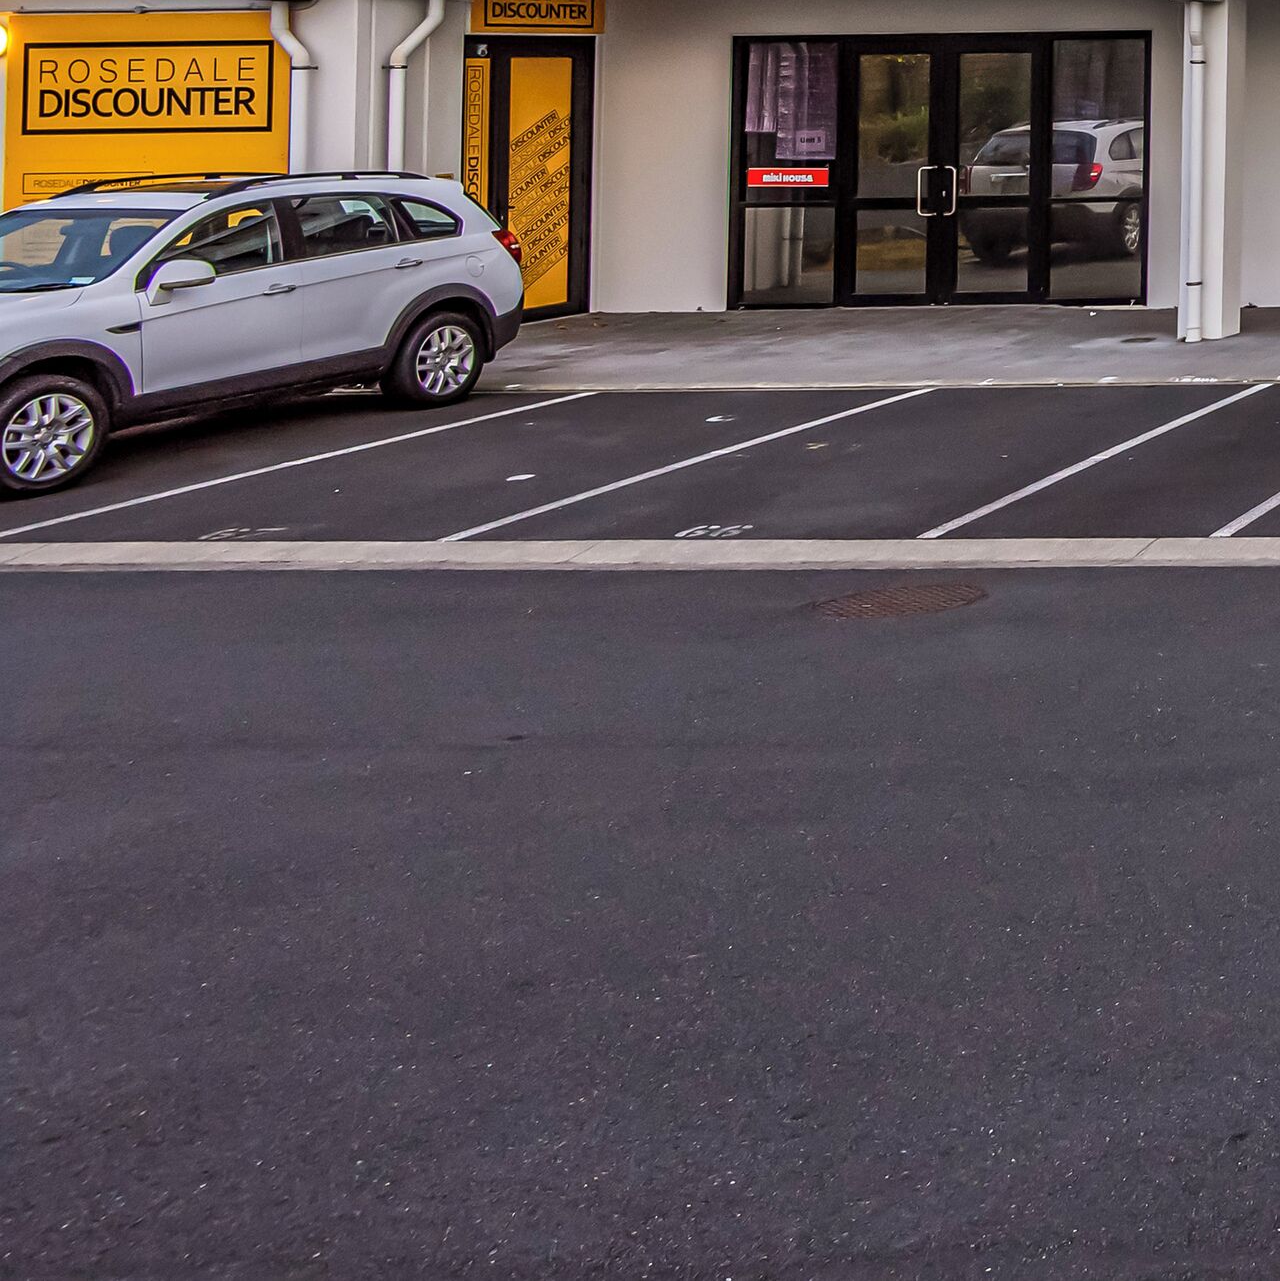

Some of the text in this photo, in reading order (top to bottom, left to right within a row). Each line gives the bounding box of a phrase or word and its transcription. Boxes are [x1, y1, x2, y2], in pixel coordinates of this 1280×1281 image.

[491, 2, 588, 20] DISCOUNTER
[39, 57, 256, 84] ROSEDALE
[38, 86, 256, 118] DISCOUNTER
[469, 68, 481, 154] ROSEDALE
[511, 111, 558, 152] DISCOUNTER
[519, 201, 567, 241] DISCOUNTER
[674, 524, 755, 538] 66
